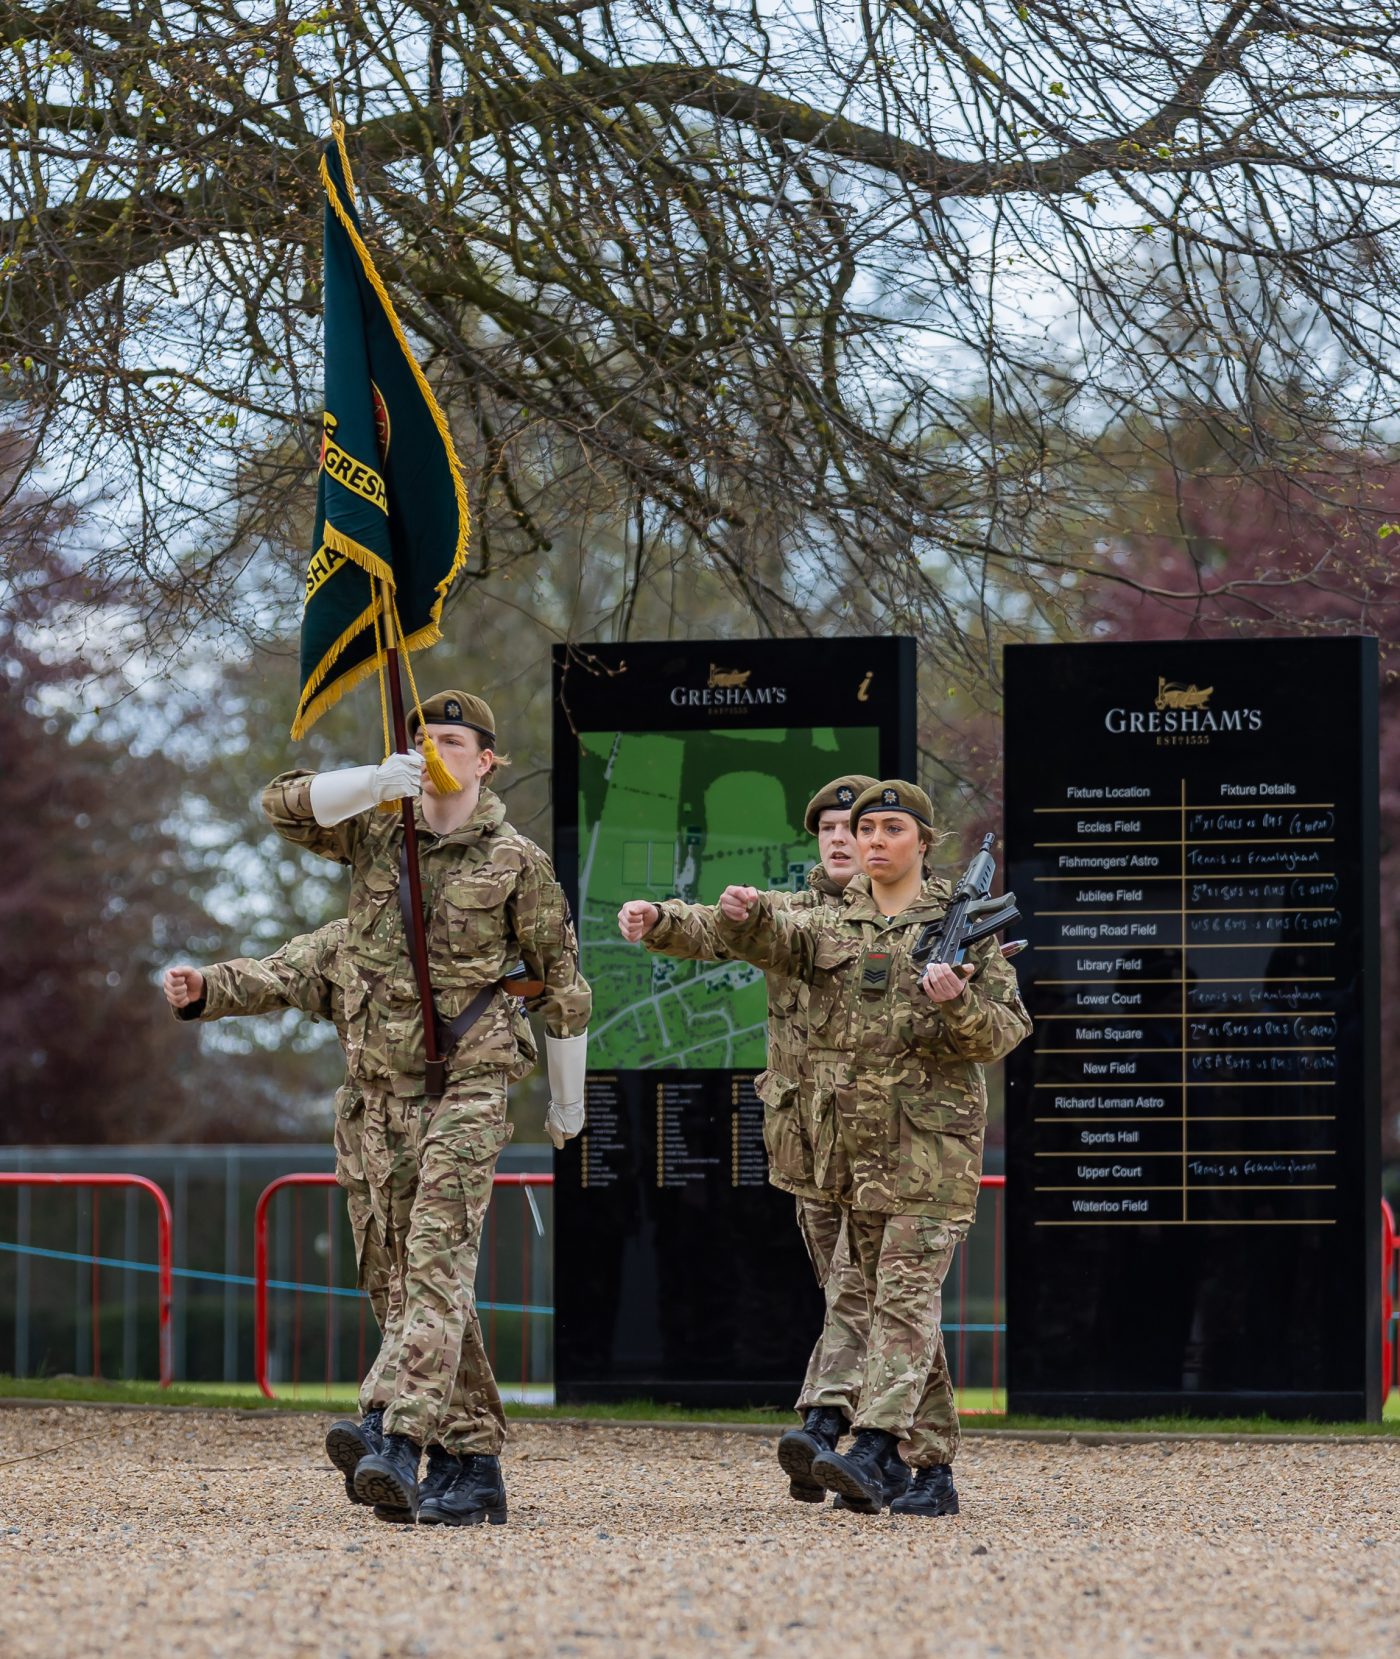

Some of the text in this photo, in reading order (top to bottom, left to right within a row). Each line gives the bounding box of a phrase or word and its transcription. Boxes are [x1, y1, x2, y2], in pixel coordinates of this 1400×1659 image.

[305, 546, 345, 597] SHA
[670, 687, 786, 706] GRESHAM'S
[1105, 709, 1262, 733] GRESHAM'S
[1067, 786, 1151, 799] Fixture Location
[1220, 783, 1296, 796] Fixture Details
[1077, 820, 1141, 833] Eccles Field
[1058, 855, 1159, 870] Fishmongers' Astro
[1075, 889, 1143, 902] Jubilee Field
[1061, 923, 1158, 939] Kelling Road Field
[1076, 958, 1142, 974] Library Field
[1076, 992, 1141, 1005] Lower Court
[1075, 1027, 1143, 1042] Main Square
[1083, 1061, 1136, 1074] New Field
[1054, 1096, 1164, 1109] Richard Leman Astro
[1080, 1130, 1139, 1145] Sports Hall
[1077, 1165, 1142, 1180] Upper Court
[1072, 1199, 1148, 1212] Waterloo Field
